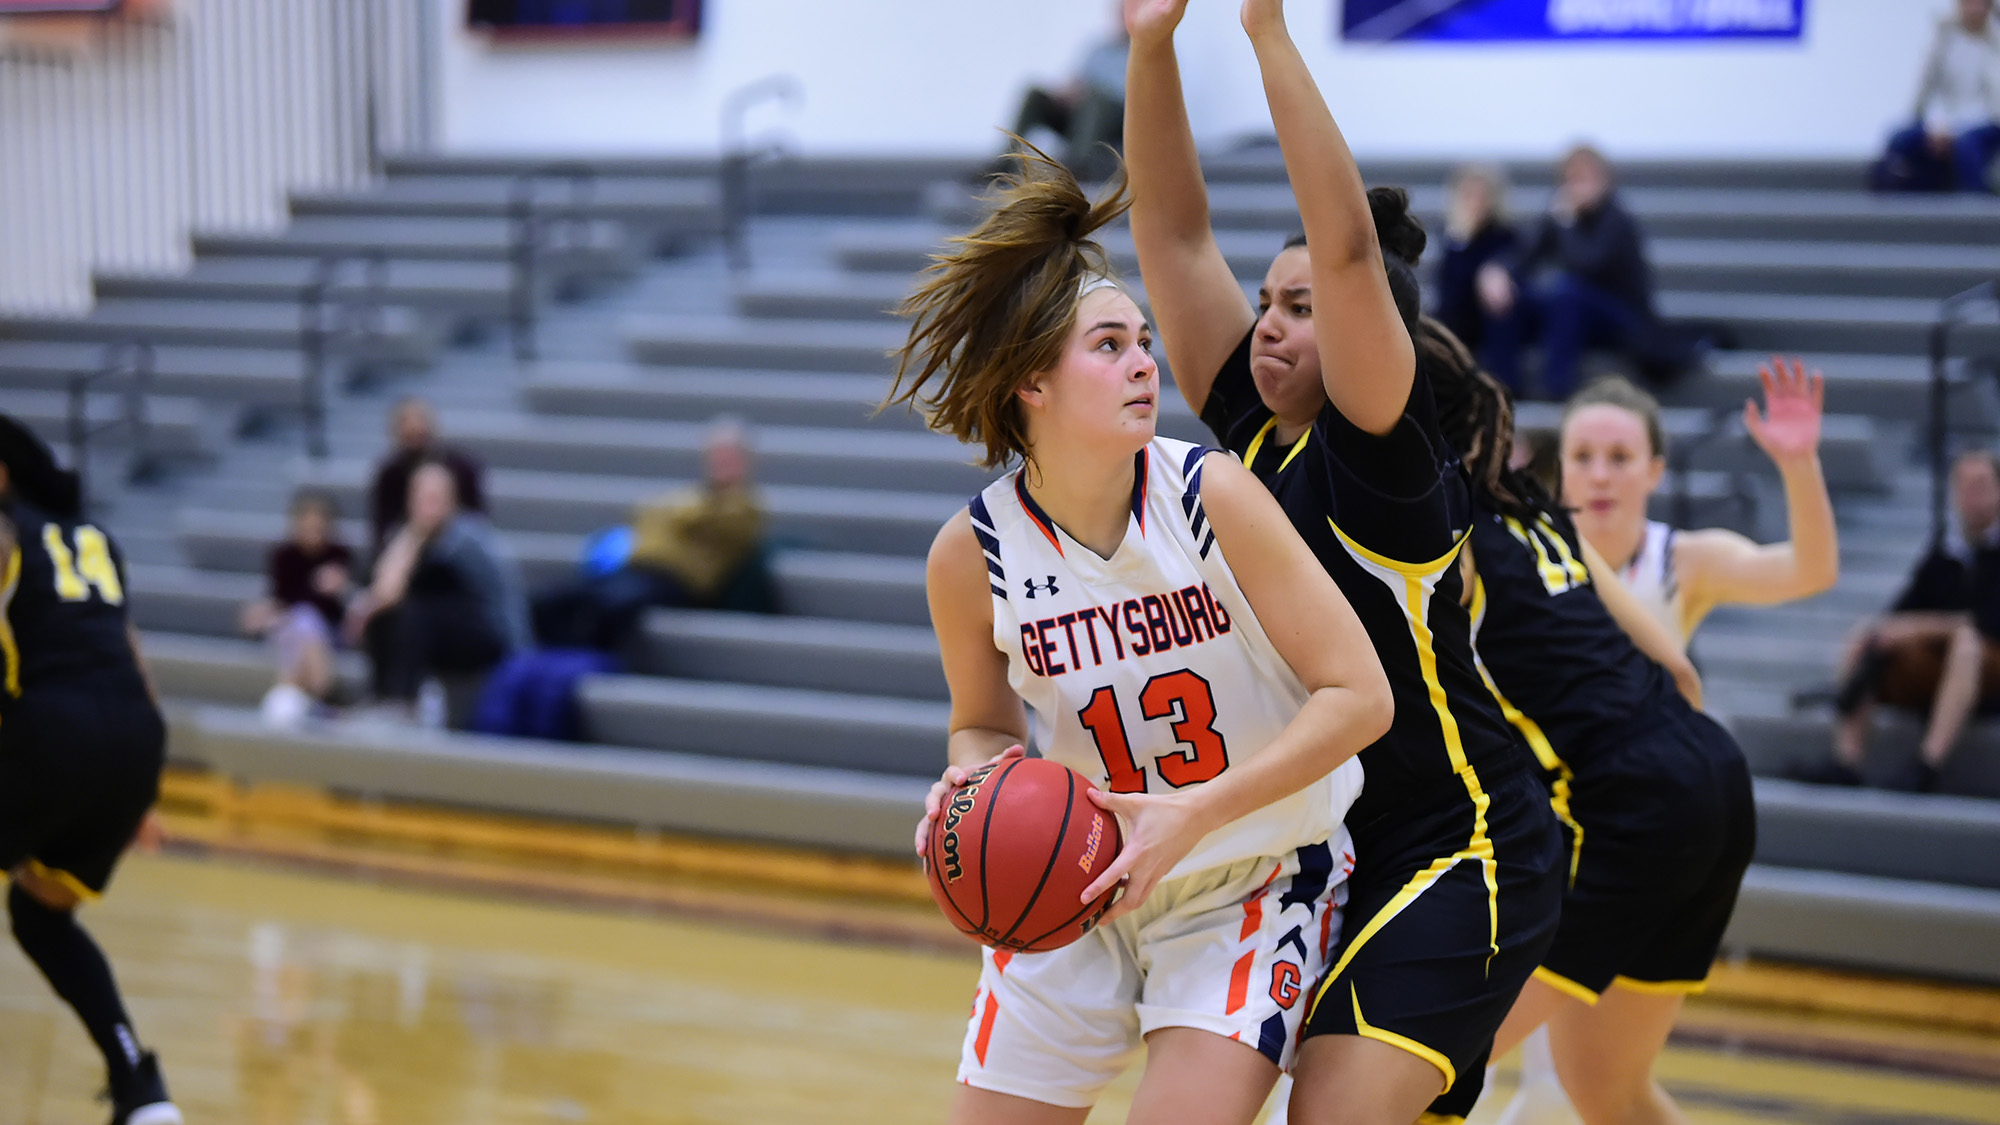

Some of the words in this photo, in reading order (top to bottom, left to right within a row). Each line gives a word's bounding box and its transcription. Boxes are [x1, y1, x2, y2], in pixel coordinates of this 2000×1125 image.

[42, 521, 125, 606] 14
[1020, 580, 1232, 677] GETTYSBURG
[1077, 667, 1230, 794] 13
[1078, 812, 1104, 875] Bullets
[1268, 959, 1302, 1011] G
